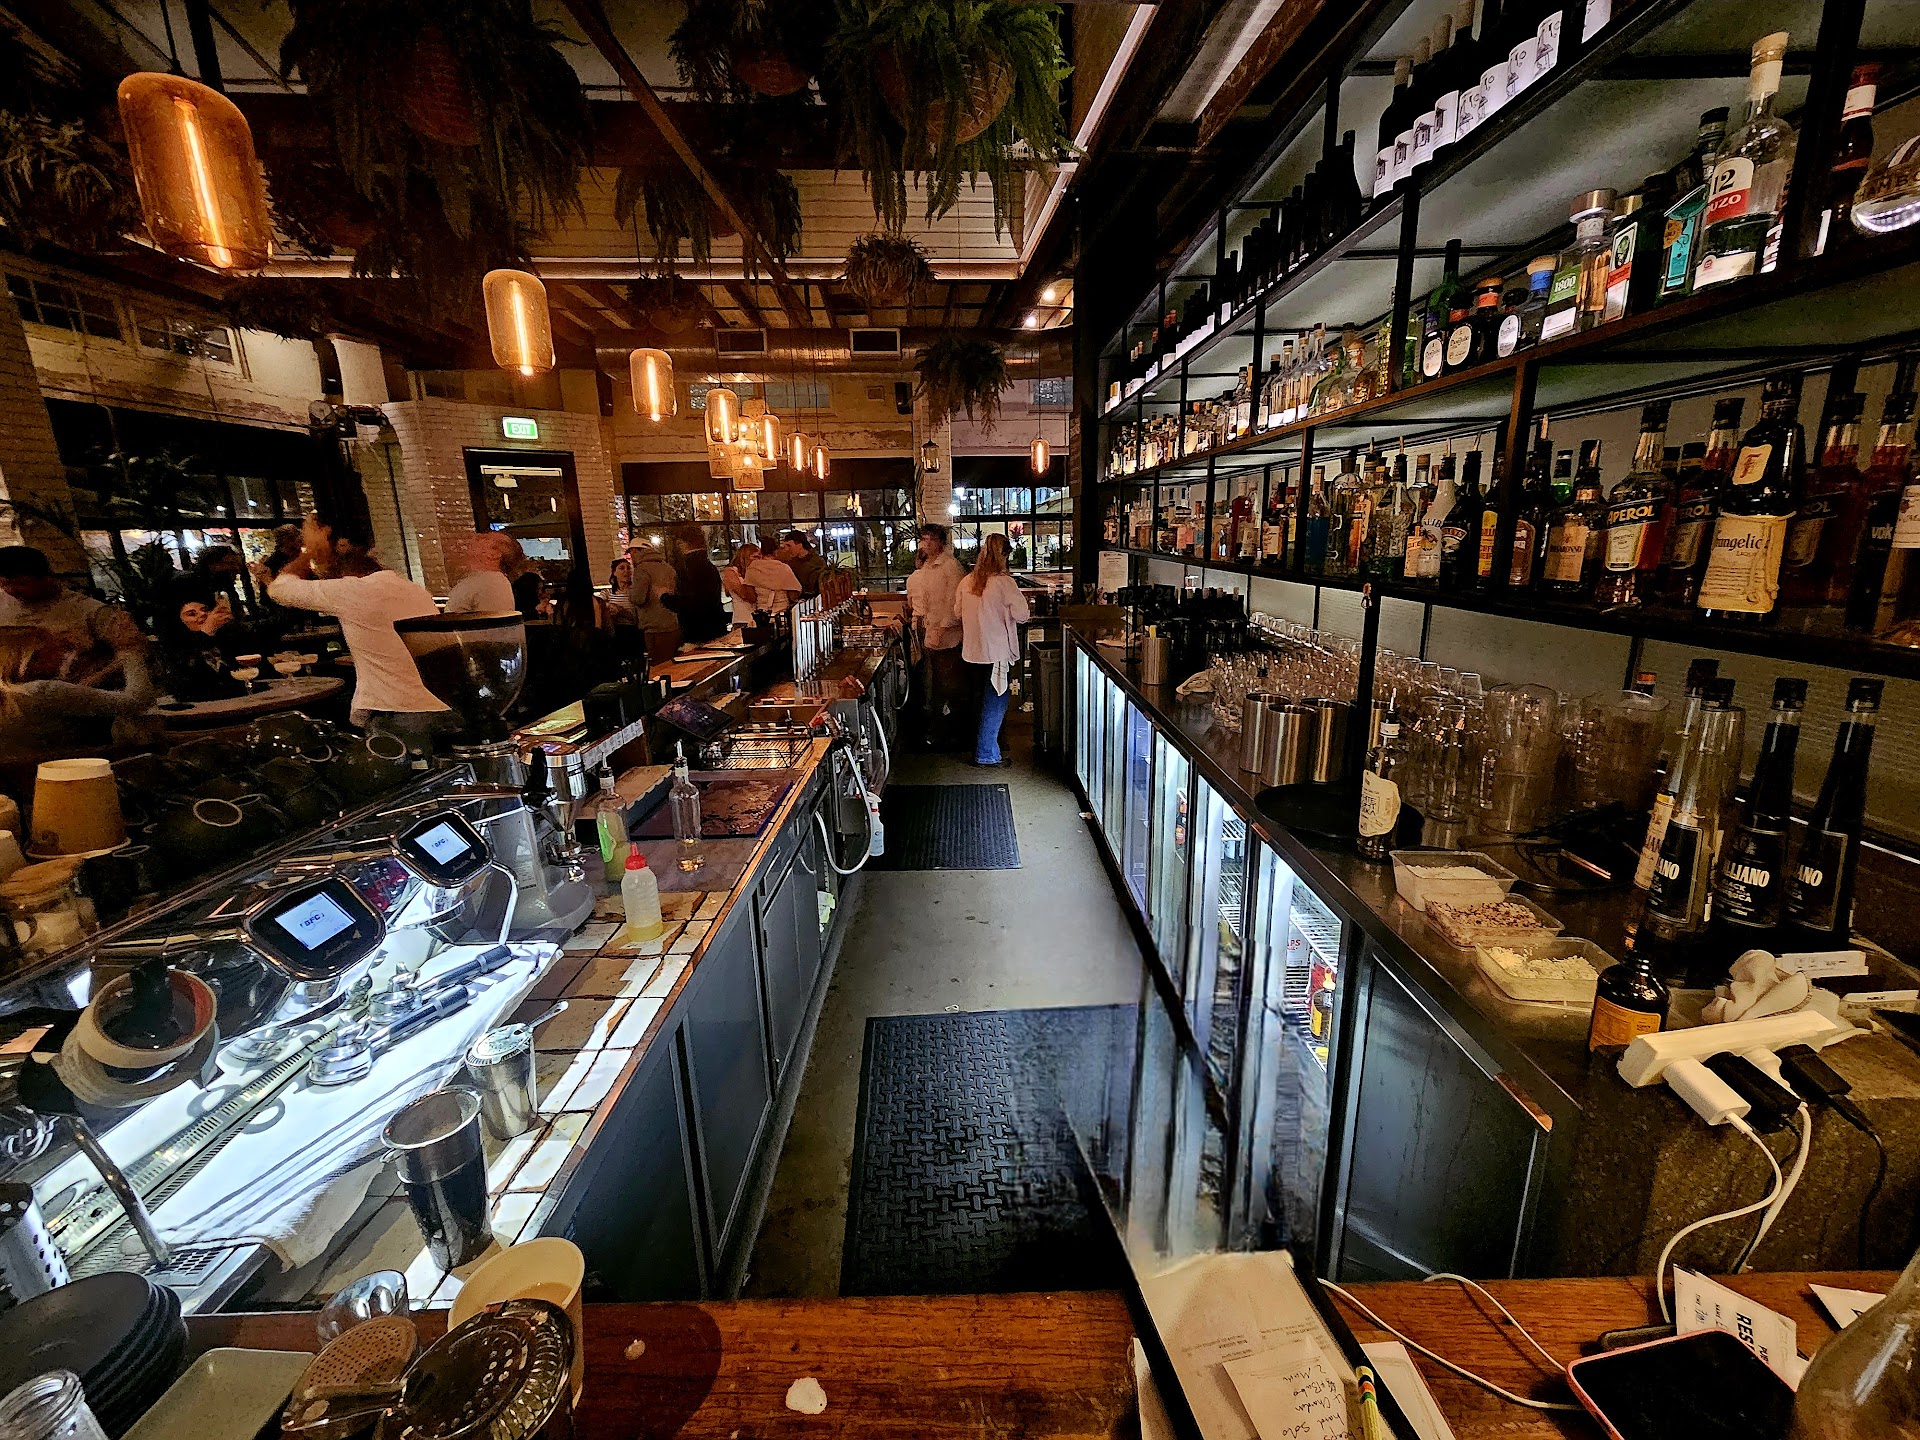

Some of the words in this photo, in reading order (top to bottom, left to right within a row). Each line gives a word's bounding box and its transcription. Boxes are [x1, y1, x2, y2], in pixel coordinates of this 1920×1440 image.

[1712, 168, 1736, 196] 12
[1709, 194, 1742, 212] UZO
[1554, 274, 1577, 293] 1800
[512, 423, 531, 436] EXIT
[1607, 504, 1655, 523] APEROL
